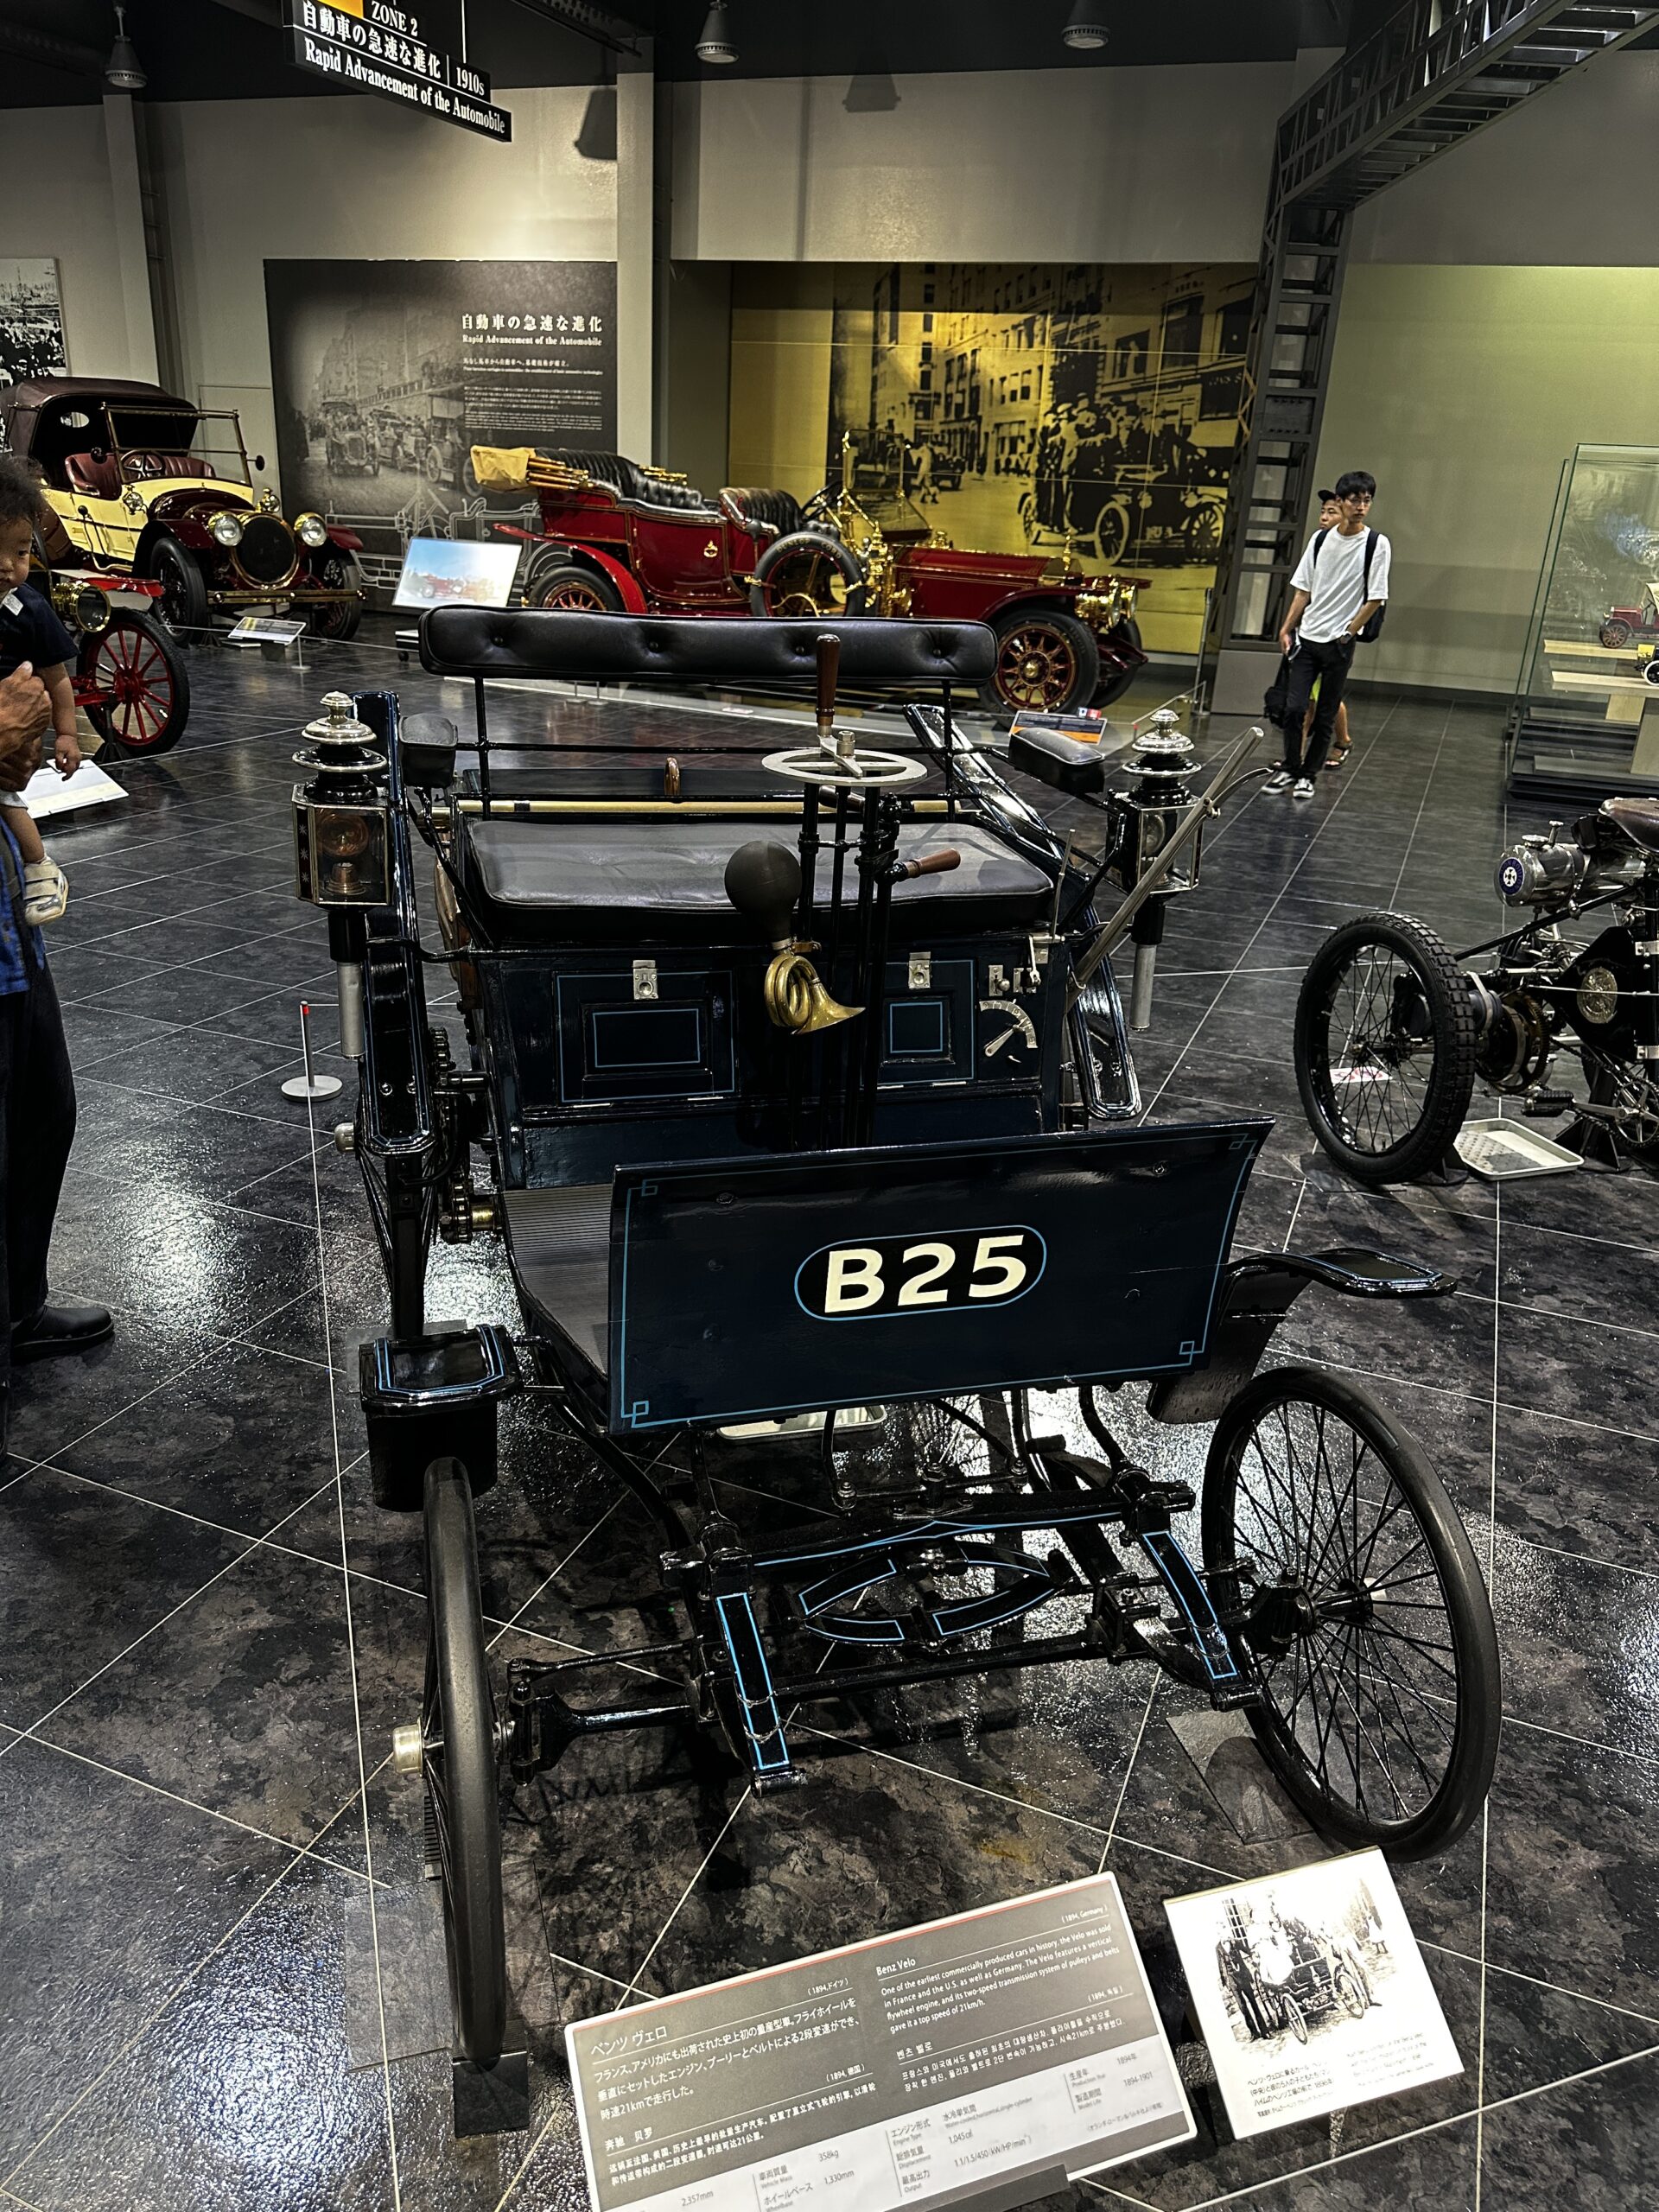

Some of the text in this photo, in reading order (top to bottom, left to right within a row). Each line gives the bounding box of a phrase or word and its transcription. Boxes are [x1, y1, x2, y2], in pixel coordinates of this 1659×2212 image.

[372, 1, 418, 37] ZONE 2
[303, 1, 441, 79] 自動車の急速な進化
[305, 37, 505, 134] Rapid Advancement of the Automobile
[456, 67, 485, 96] 1910s
[462, 314, 602, 333] 自動車の急速な進化
[462, 334, 602, 346] Rapid Advancement of the Automobile
[824, 1234, 1027, 1313] B25
[875, 1955, 916, 1976] Benz Velo
[880, 1985, 895, 1996] One
[895, 1982, 904, 1992] of
[904, 1979, 916, 1989] the
[916, 1972, 941, 1986] earliest
[940, 1959, 984, 1980] commercially
[983, 1951, 1014, 1967] produced
[1027, 1944, 1036, 1954] in
[1035, 1937, 1059, 1953] history,
[1058, 1935, 1071, 1944] the
[1070, 1930, 1084, 1942] Velo
[1085, 1929, 1098, 1937] was
[1097, 1923, 1112, 1934] sold
[883, 1999, 892, 2008] in
[892, 1992, 917, 2005] France
[917, 1987, 931, 1998] and
[931, 1984, 944, 1993] the
[944, 1980, 958, 1990] U.S.
[968, 1972, 983, 1983] well
[992, 1960, 1025, 1978] Germany.
[1025, 1956, 1038, 1967] The
[1038, 1951, 1054, 1962] Velo
[1054, 1943, 1081, 1958] features
[1087, 1935, 1112, 1948] vertical
[886, 1945, 1120, 2021] flywheel engine, and its two-speed transmission system of pulleys and belts
[889, 2022, 907, 2034] gave
[906, 2018, 912, 2028] it
[918, 2014, 931, 2026] top
[930, 2007, 951, 2022] speed
[950, 2005, 959, 2014] of
[959, 1997, 986, 2012] 21km/h.
[589, 2023, 667, 2059] ベンツ ヴェロ
[594, 1996, 856, 2083] フランス、アメリカにも出荷された史上初の量産型車。フライホイールを
[896, 2046, 914, 2060] 벤츠
[600, 2082, 694, 2120] 時速21kmで走行した。
[604, 2126, 653, 2152] 奔驰 贝罗
[818, 2147, 839, 2164] 358kg
[823, 2168, 855, 2186] 1,330mm
[681, 2188, 714, 2208] 2,357mm
